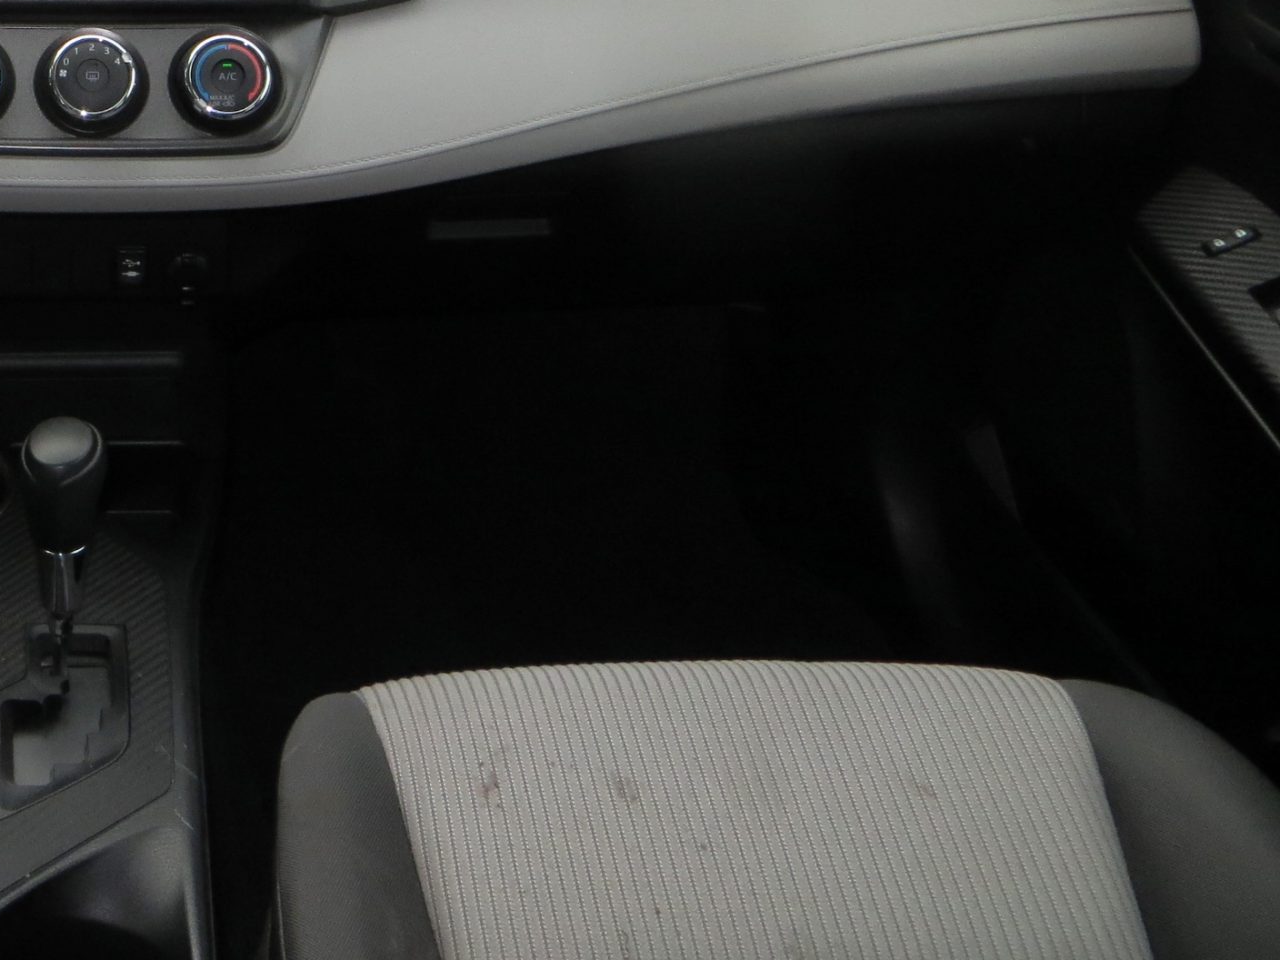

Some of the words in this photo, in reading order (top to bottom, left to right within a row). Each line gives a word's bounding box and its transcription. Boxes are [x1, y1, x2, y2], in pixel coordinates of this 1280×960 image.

[74, 47, 79, 55] 1
[89, 44, 95, 52] 2
[104, 47, 110, 55] 3
[63, 58, 70, 66] 0
[114, 58, 121, 66] 4
[219, 72, 237, 81] A/C
